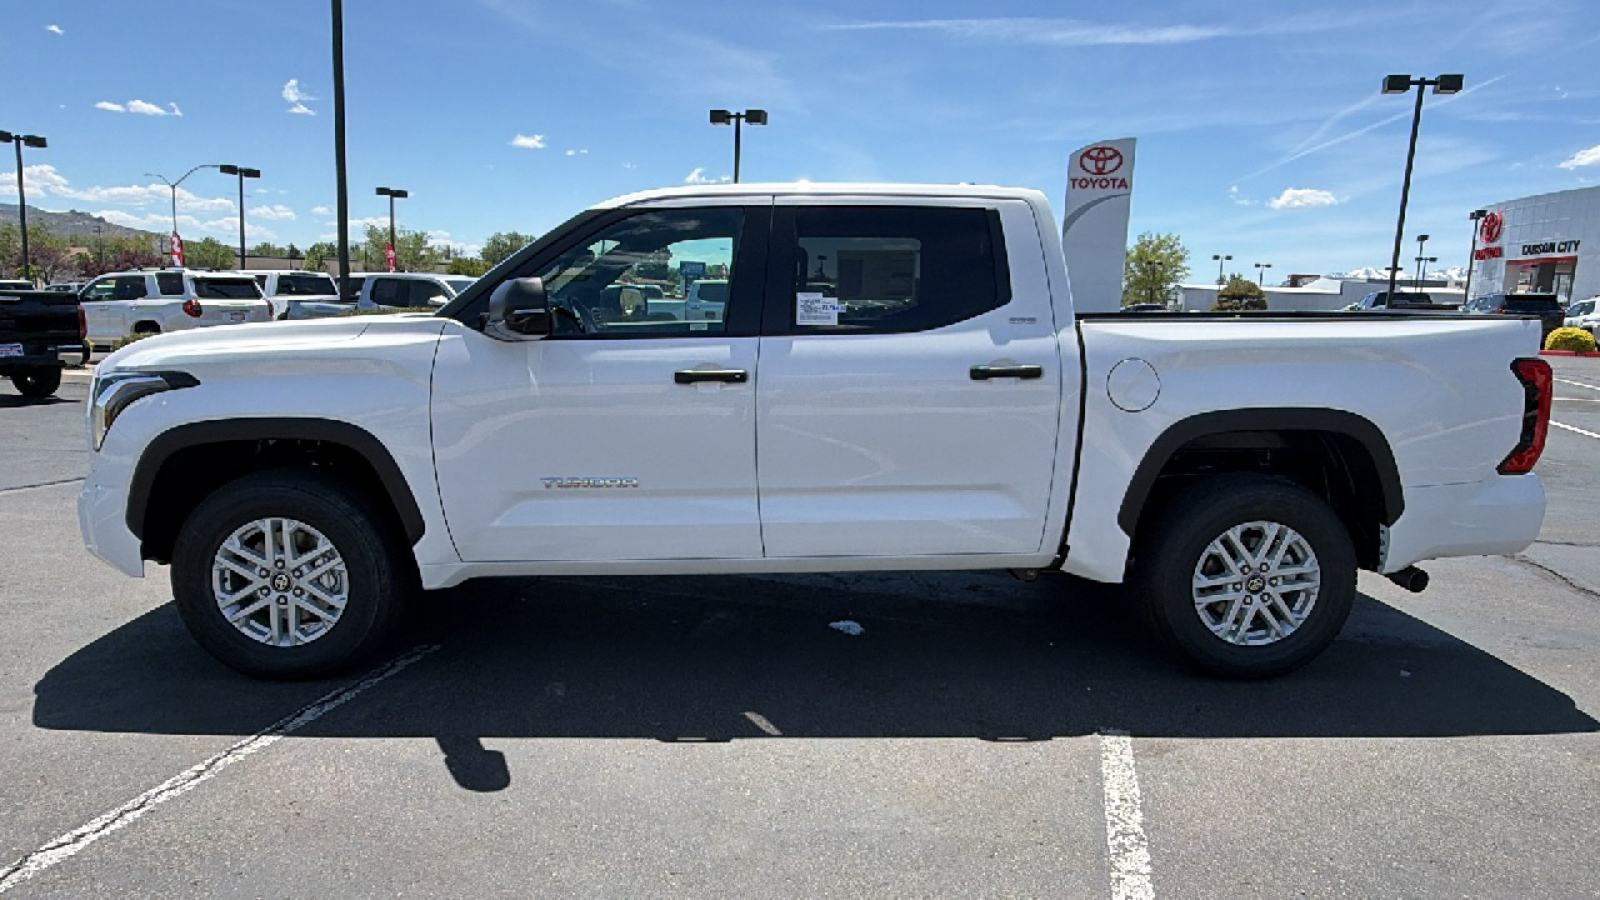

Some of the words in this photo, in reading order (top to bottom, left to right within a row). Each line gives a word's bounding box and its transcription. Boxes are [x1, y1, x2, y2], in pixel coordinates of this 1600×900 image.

[1070, 178, 1128, 189] TOYOTA
[1522, 242, 1556, 255] CARSON
[1558, 240, 1580, 253] CITY
[540, 477, 638, 488] TUNDRA
